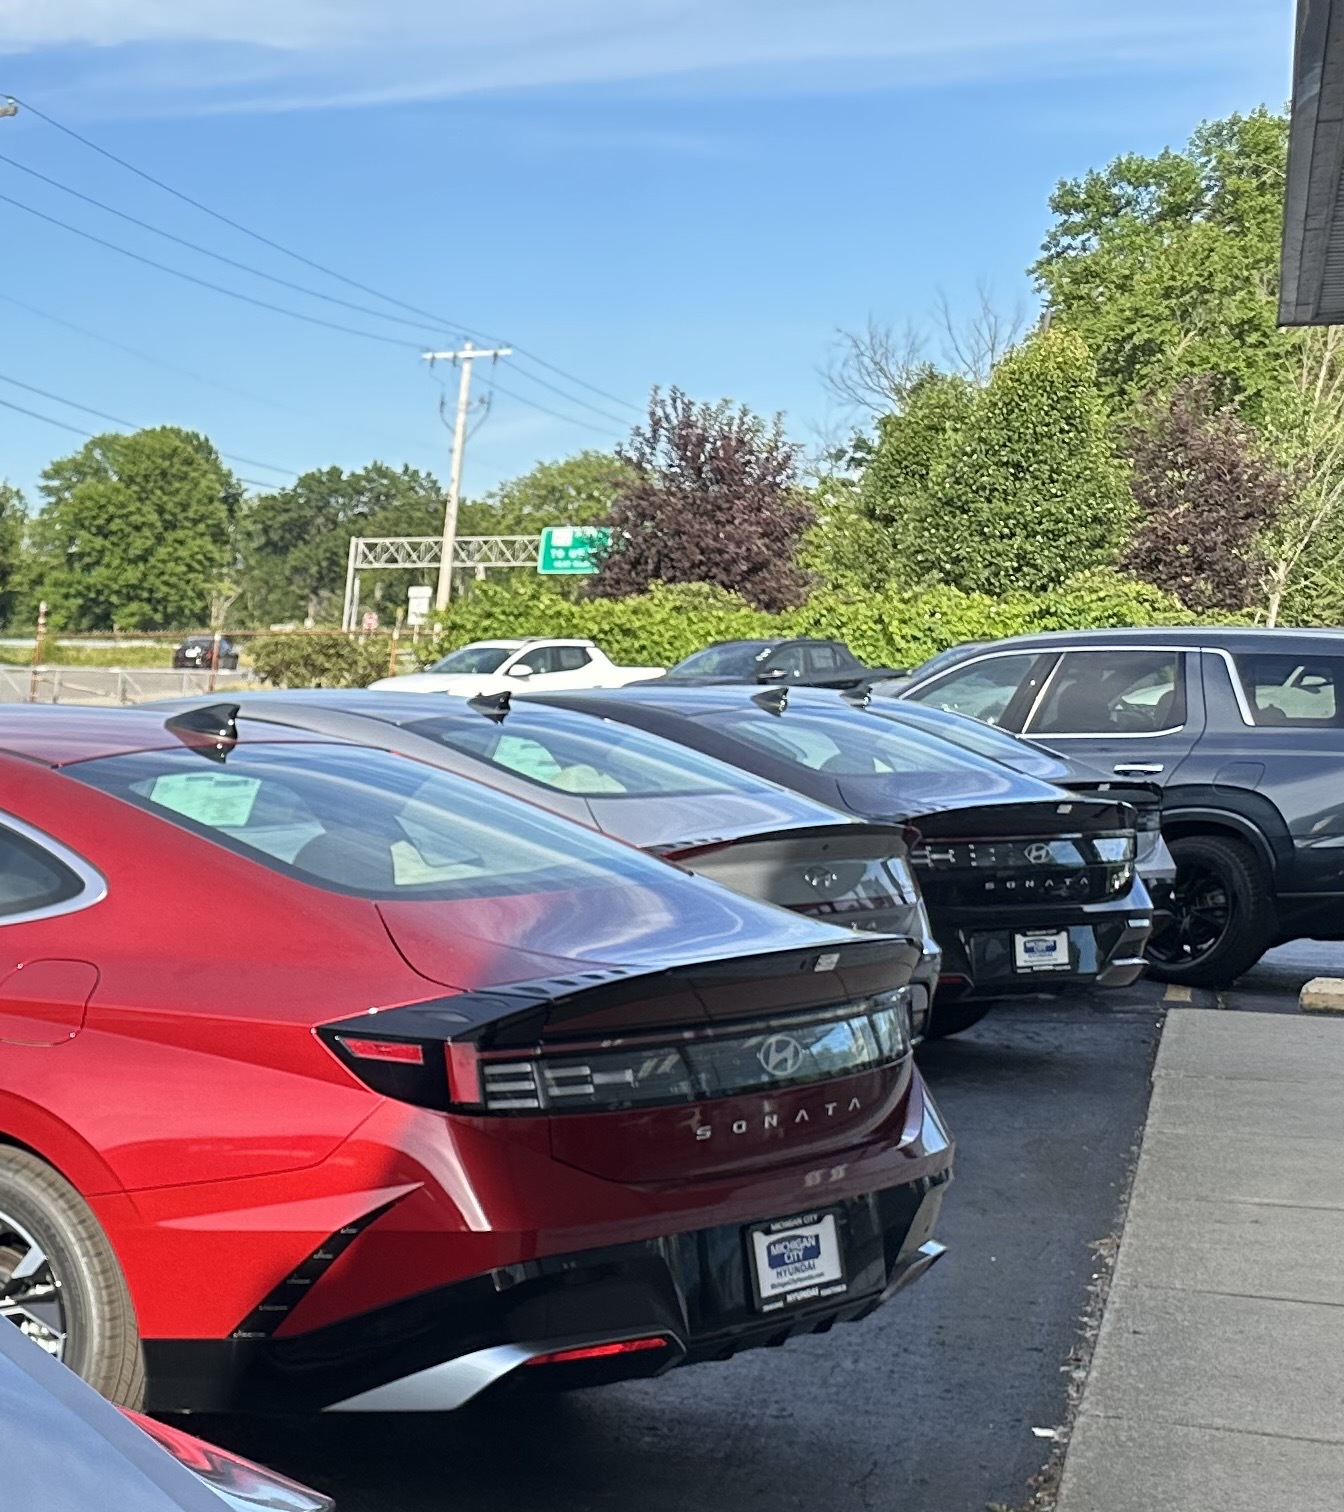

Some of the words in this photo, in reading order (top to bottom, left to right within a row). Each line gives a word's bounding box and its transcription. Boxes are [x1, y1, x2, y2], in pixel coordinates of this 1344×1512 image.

[984, 876, 1089, 891] SONATA
[696, 1097, 861, 1141] SONATA
[770, 1235, 816, 1256] MICHIGAN
[783, 1248, 804, 1264] CITY
[776, 1260, 816, 1278] HYUNDAI
